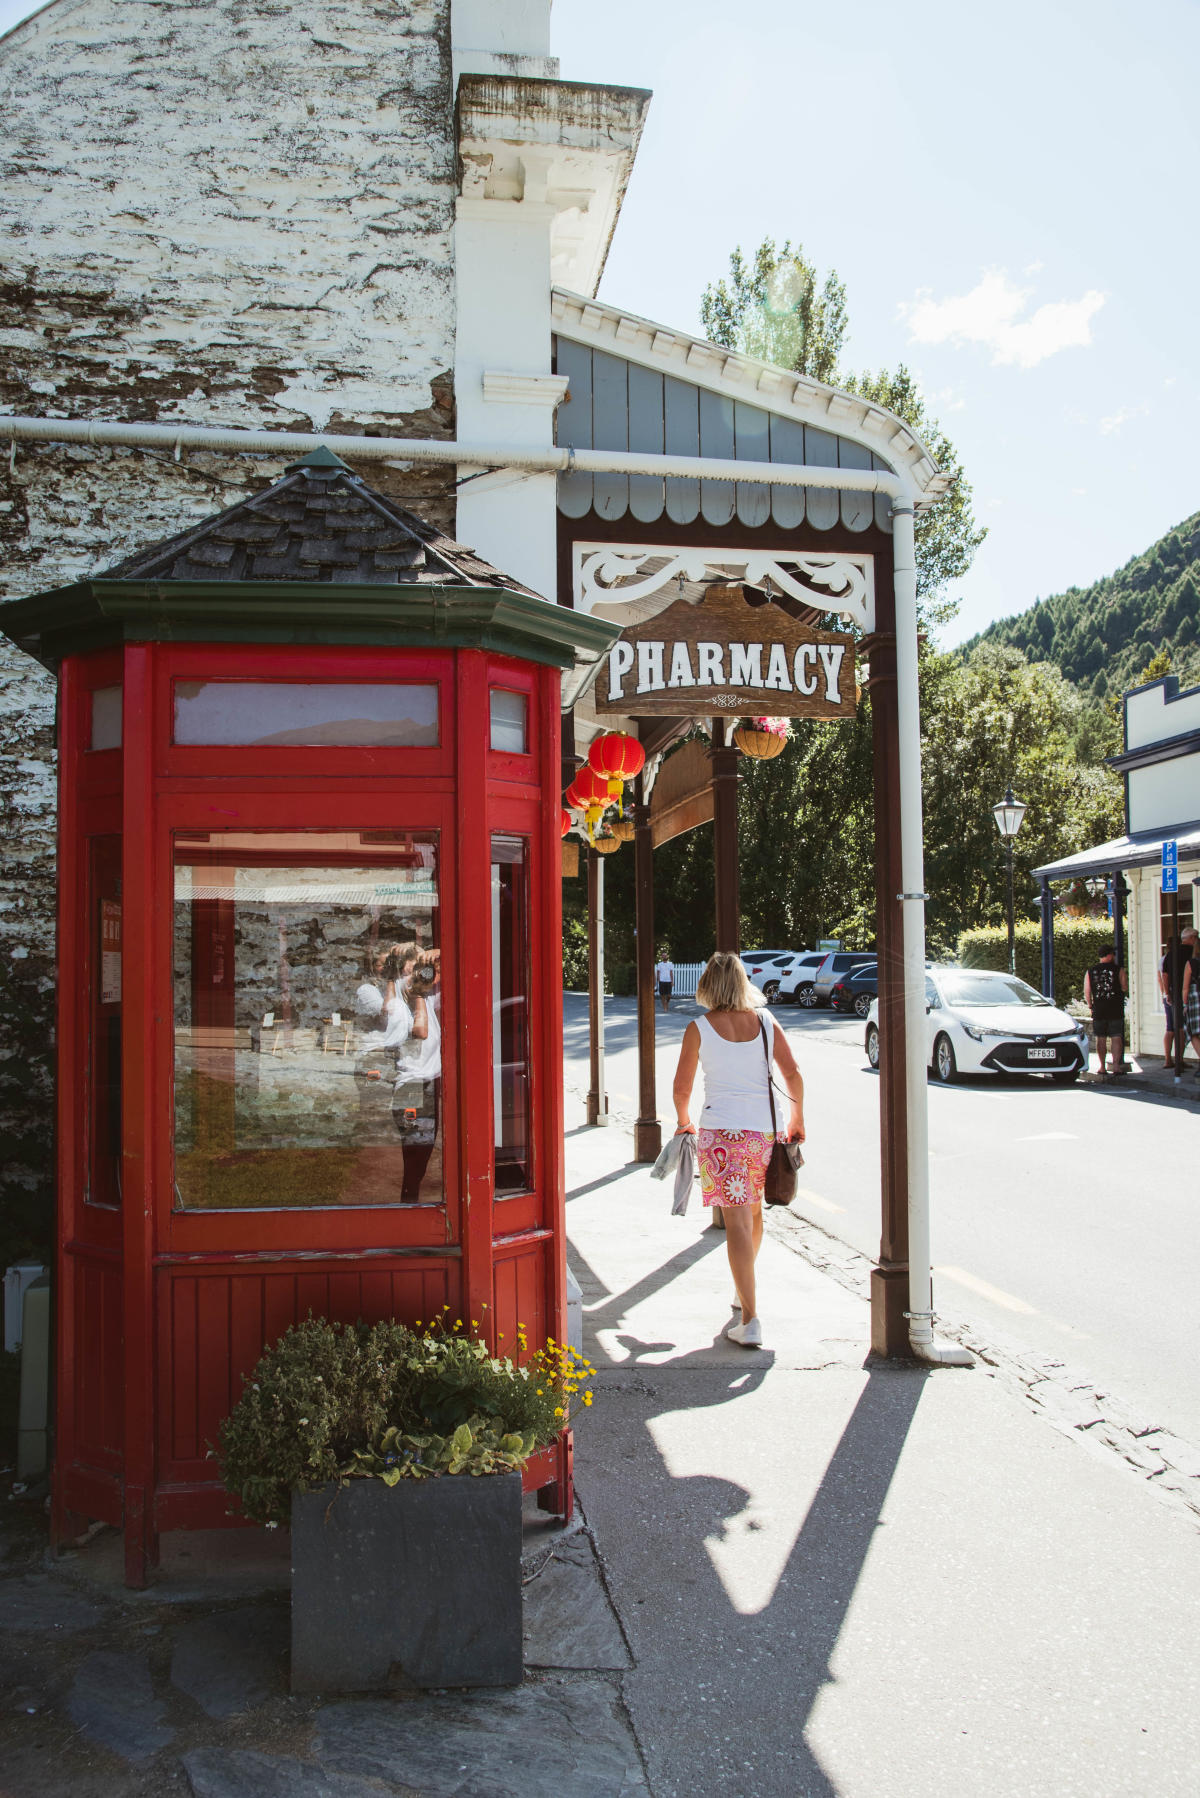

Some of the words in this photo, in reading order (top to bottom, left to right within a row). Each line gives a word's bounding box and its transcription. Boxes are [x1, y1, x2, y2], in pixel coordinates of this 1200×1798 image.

[607, 640, 845, 704] PHARMACY
[1166, 843, 1173, 852] P
[1166, 868, 1173, 879] P
